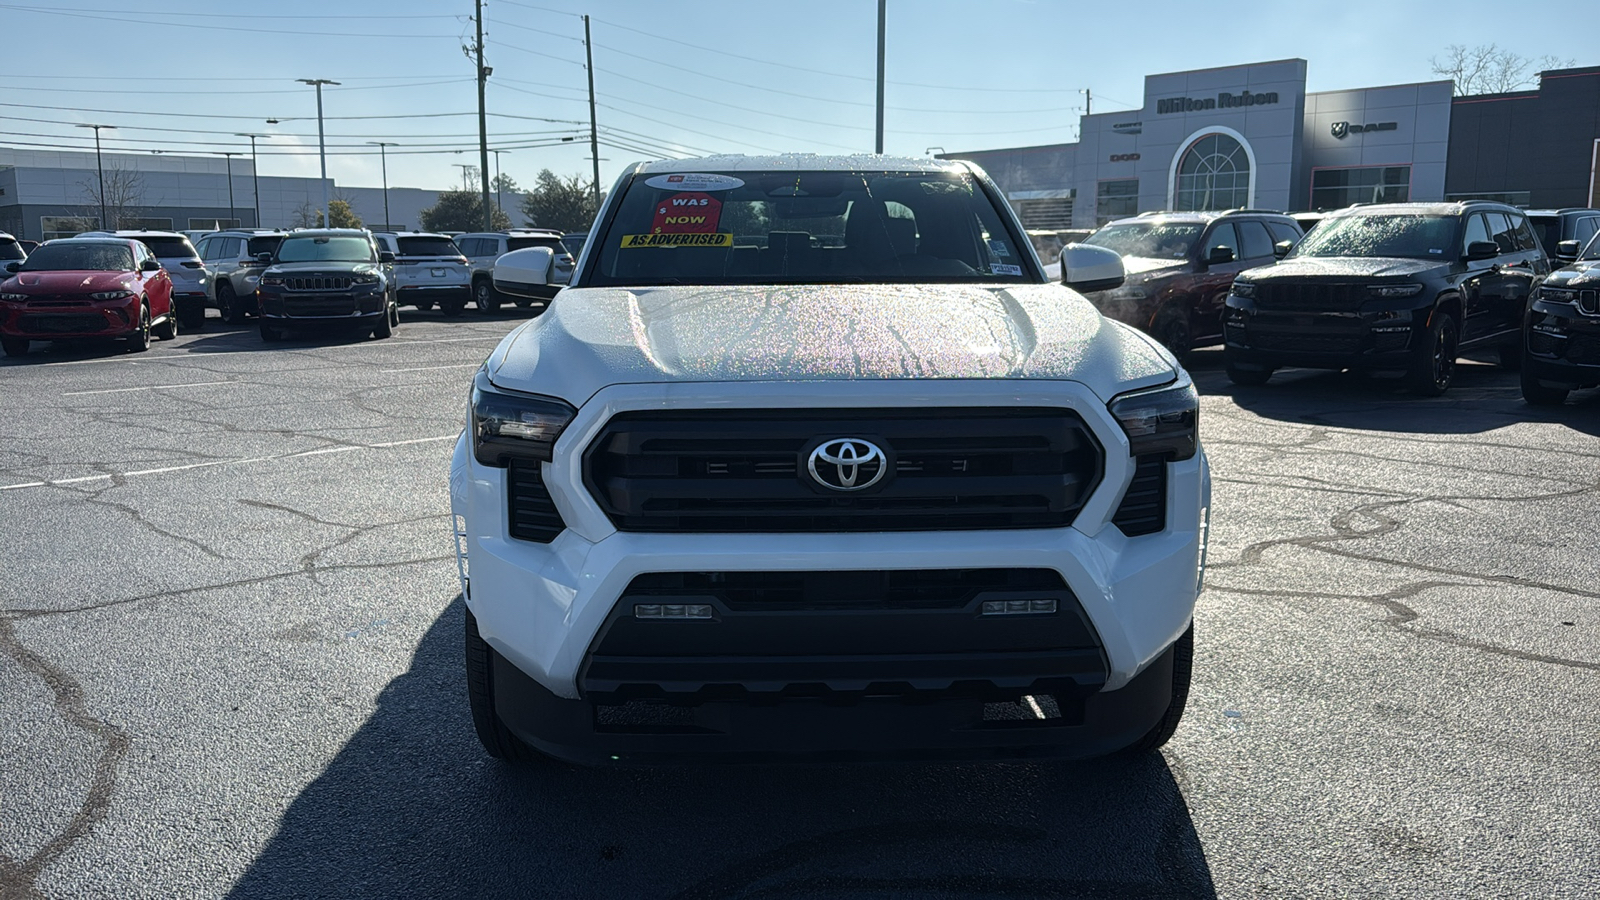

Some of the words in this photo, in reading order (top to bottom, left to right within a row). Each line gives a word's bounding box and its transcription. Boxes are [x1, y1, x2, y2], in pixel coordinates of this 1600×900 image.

[1157, 97, 1215, 114] Milton
[1217, 90, 1278, 108] Ruben
[628, 236, 648, 246] AS
[647, 234, 727, 245] ADVERTISED
